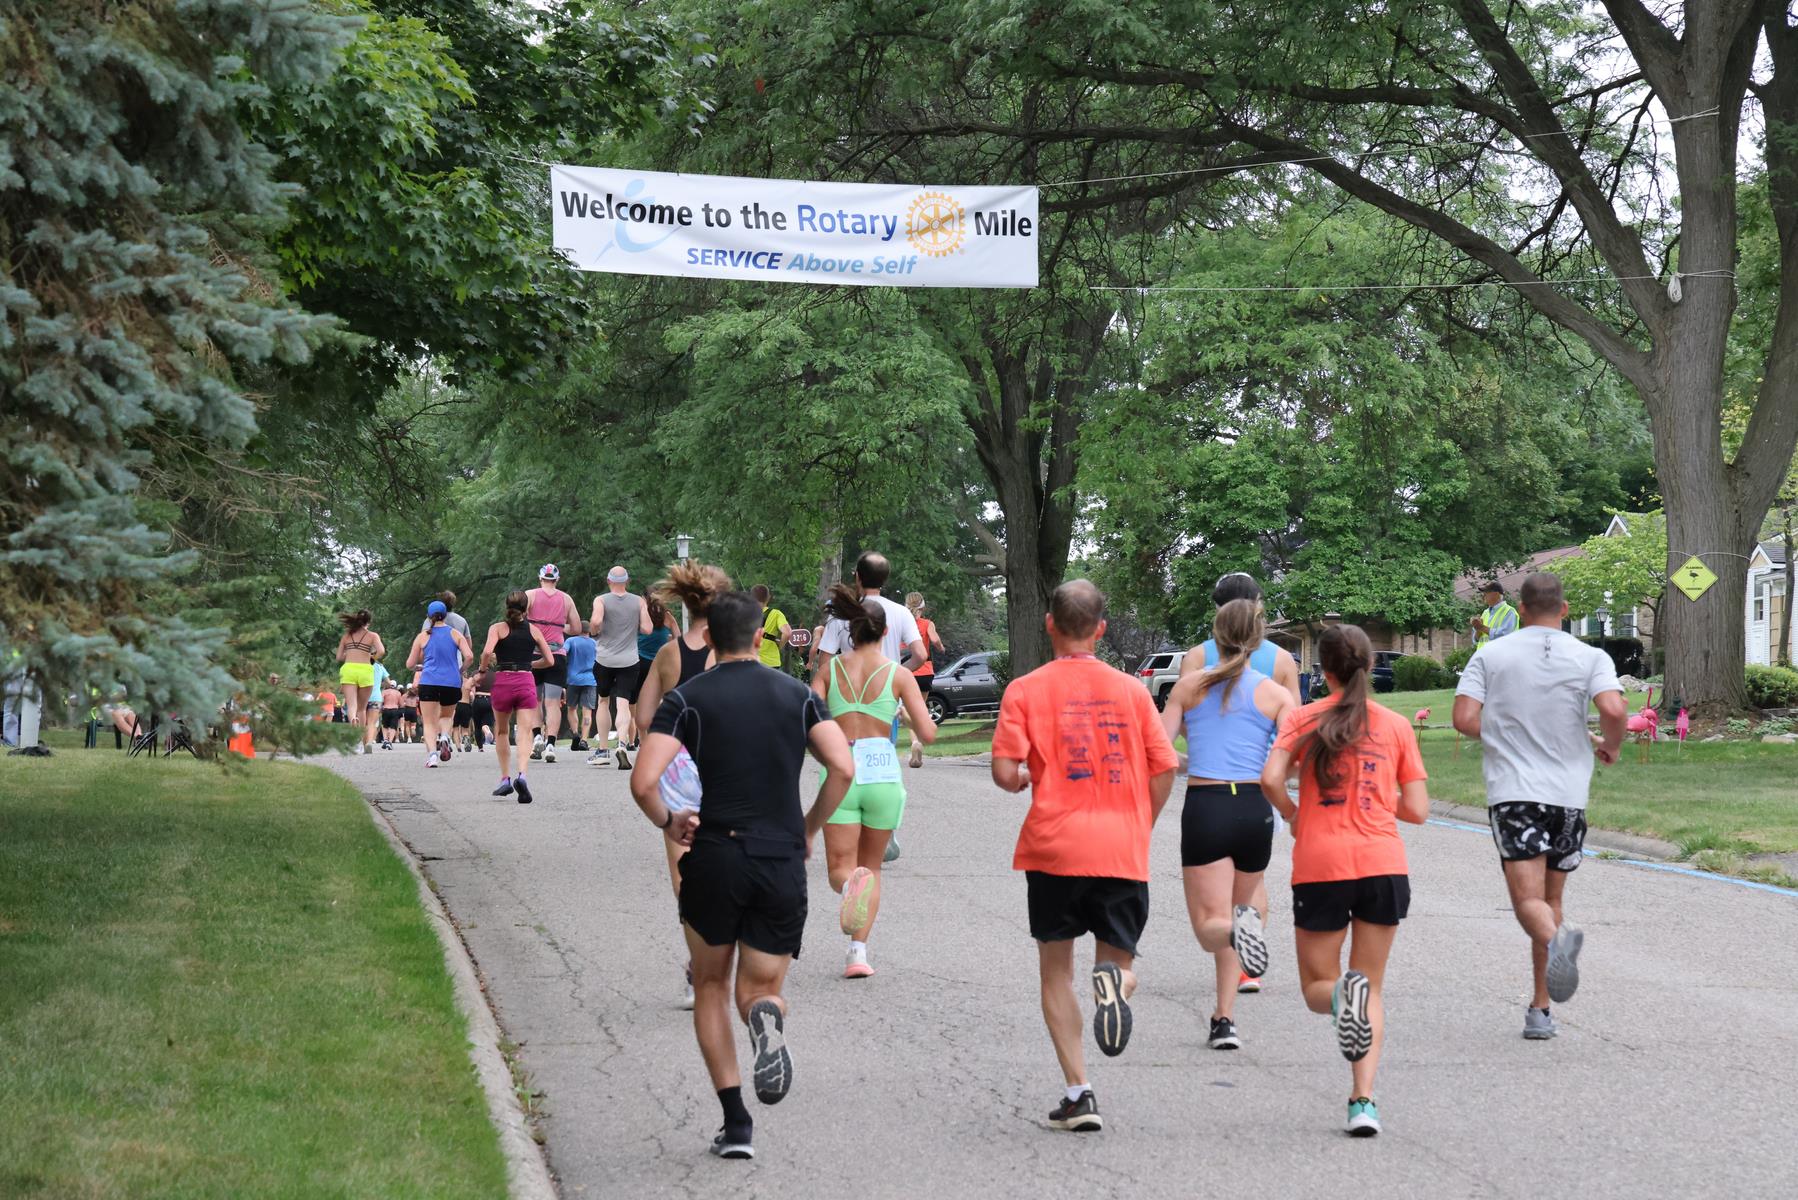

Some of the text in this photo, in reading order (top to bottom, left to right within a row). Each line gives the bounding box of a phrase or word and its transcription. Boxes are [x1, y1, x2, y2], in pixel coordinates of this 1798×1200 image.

[560, 191, 1032, 242] Welcome to the Rotary Mile
[687, 247, 918, 275] SERVICE Above Self
[792, 633, 807, 642] 3216
[865, 753, 891, 767] 2507
